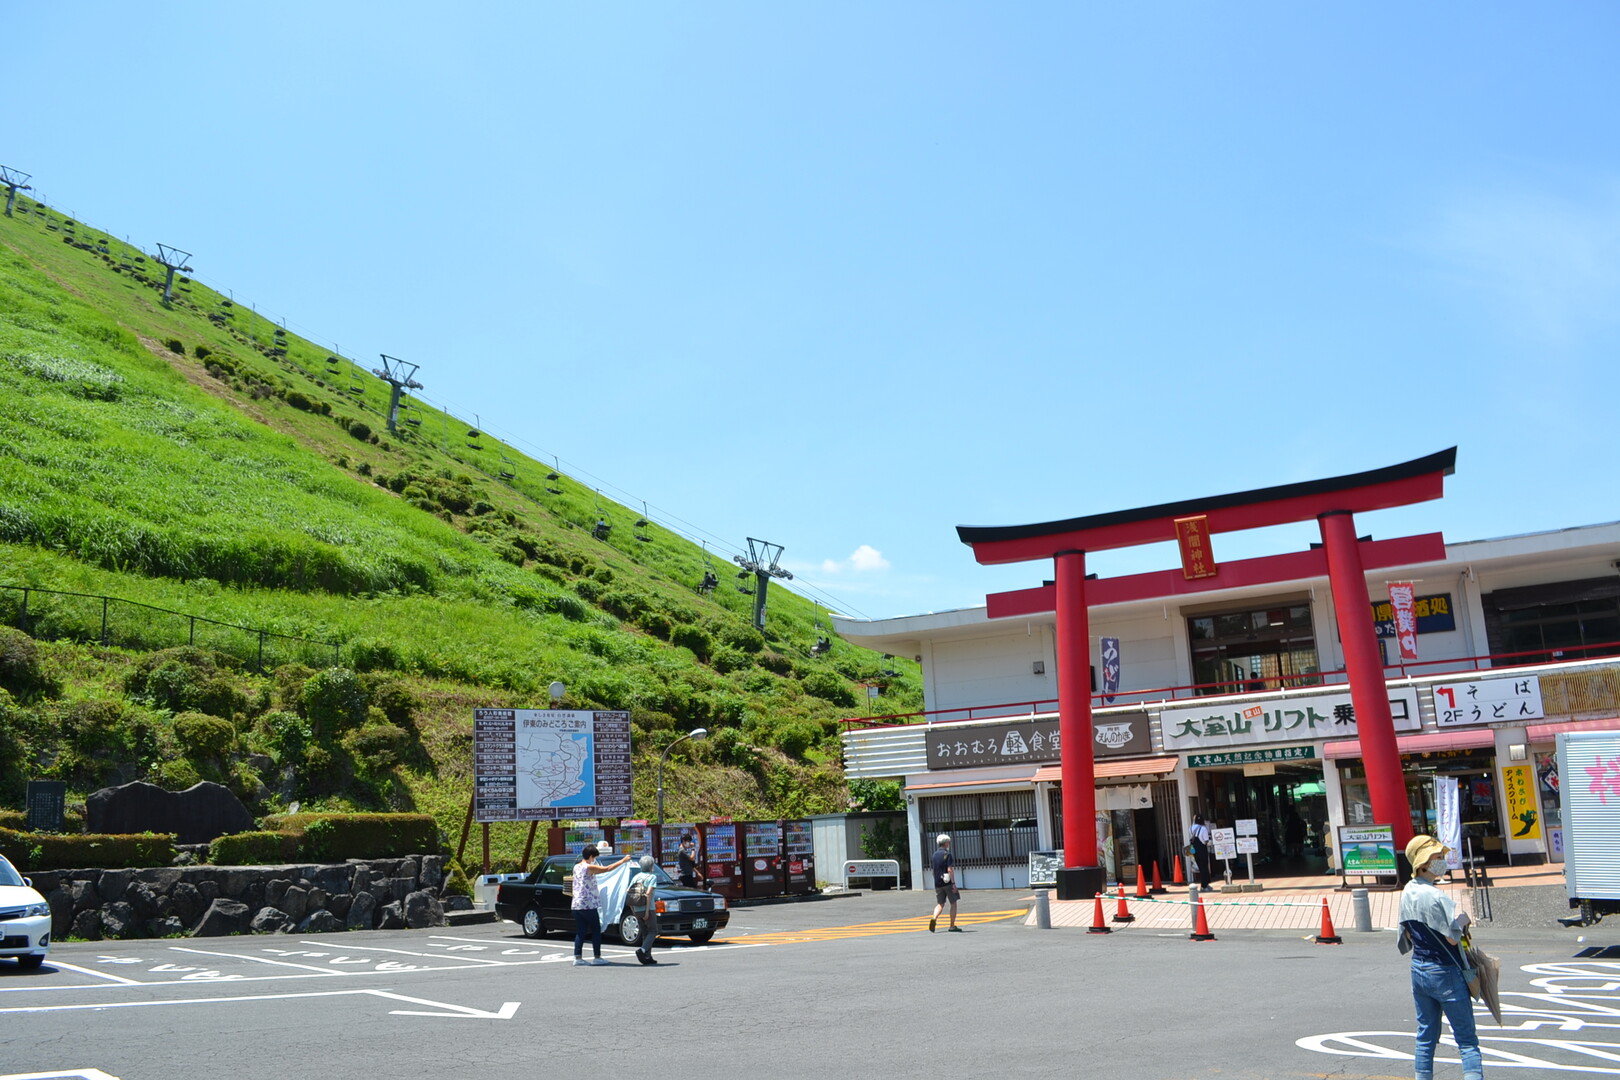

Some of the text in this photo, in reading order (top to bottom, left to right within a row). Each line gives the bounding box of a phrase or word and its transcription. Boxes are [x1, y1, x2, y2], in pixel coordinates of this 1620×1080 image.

[1466, 680, 1532, 701] そば
[1442, 701, 1536, 723] 2F うどん
[523, 719, 587, 729] 伊東のみどころご案内
[1505, 769, 1519, 820] アイスクリーム
